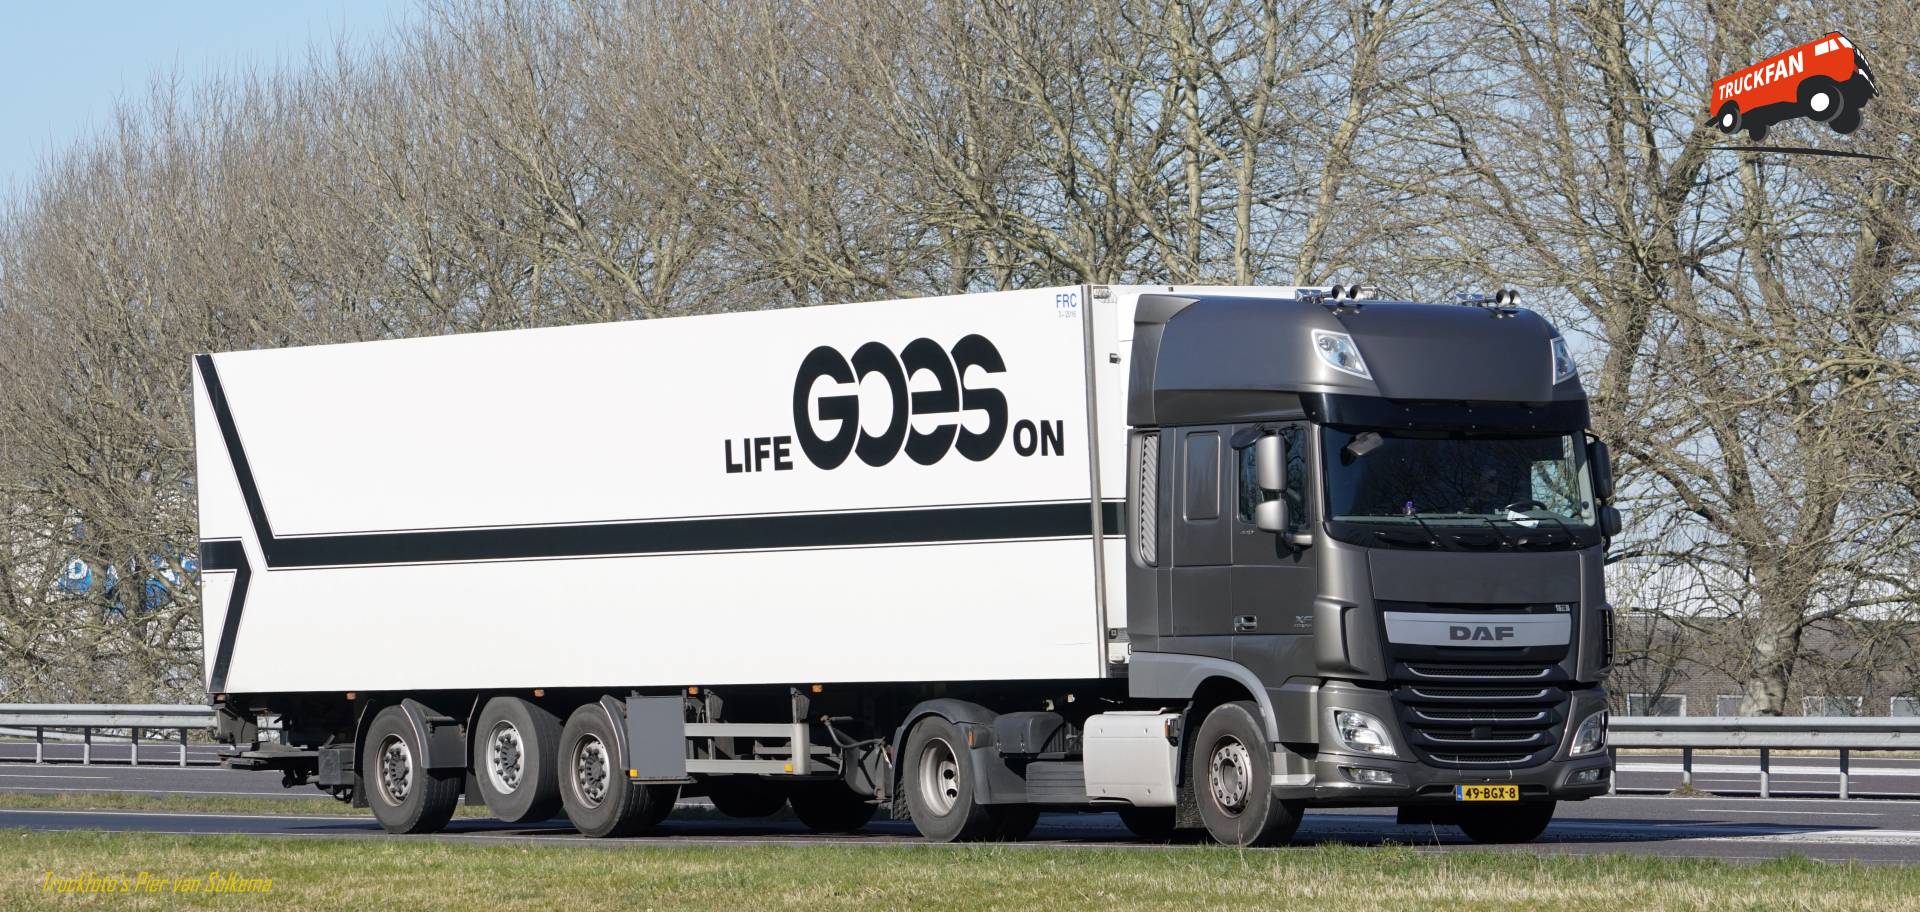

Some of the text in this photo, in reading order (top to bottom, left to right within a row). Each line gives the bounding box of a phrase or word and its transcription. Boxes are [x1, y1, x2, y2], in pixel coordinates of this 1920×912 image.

[1056, 293, 1077, 308] FRC
[725, 436, 793, 473] LIFE
[1013, 419, 1065, 457] ON
[1450, 626, 1514, 641] DAF
[1465, 787, 1516, 799] 49-BGX-8
